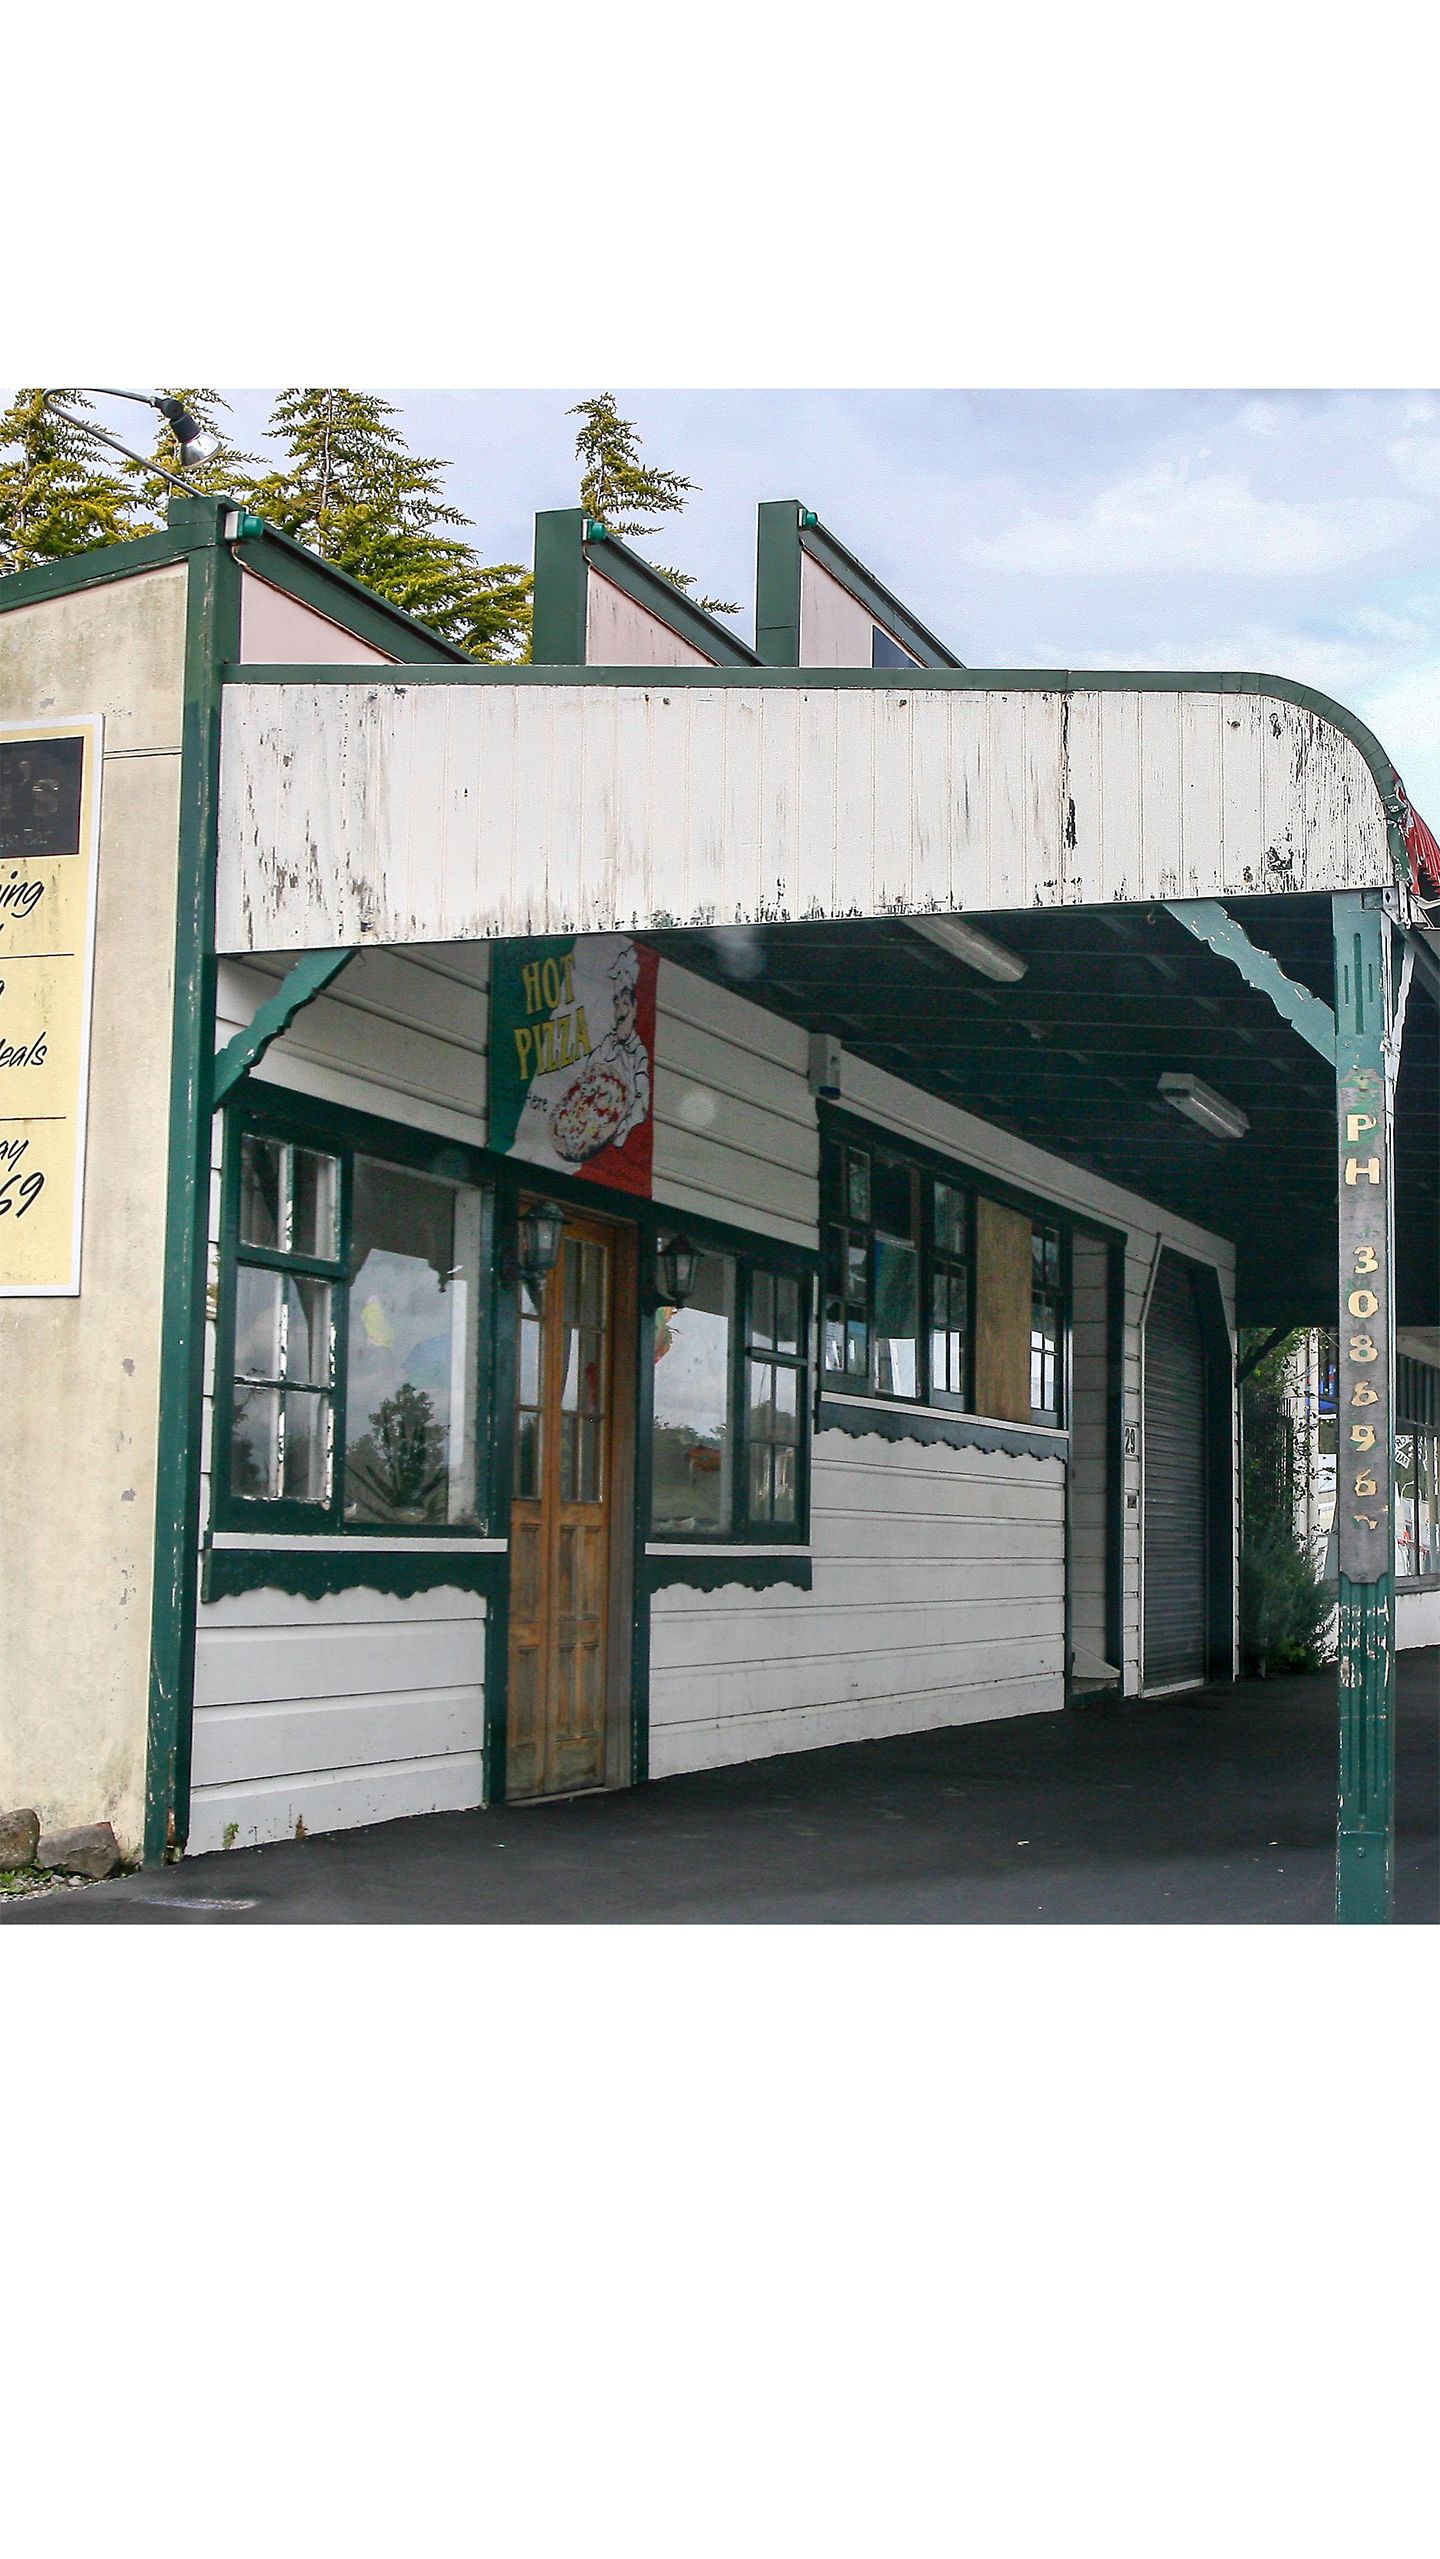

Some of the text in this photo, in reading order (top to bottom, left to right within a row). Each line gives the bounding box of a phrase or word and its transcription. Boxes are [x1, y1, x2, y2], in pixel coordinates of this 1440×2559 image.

[0, 870, 45, 919] ing
[520, 952, 576, 1015] HOT
[514, 1005, 593, 1081] PIZZA
[1345, 1113, 1381, 1186] PH
[1125, 1427, 1136, 1454] 29
